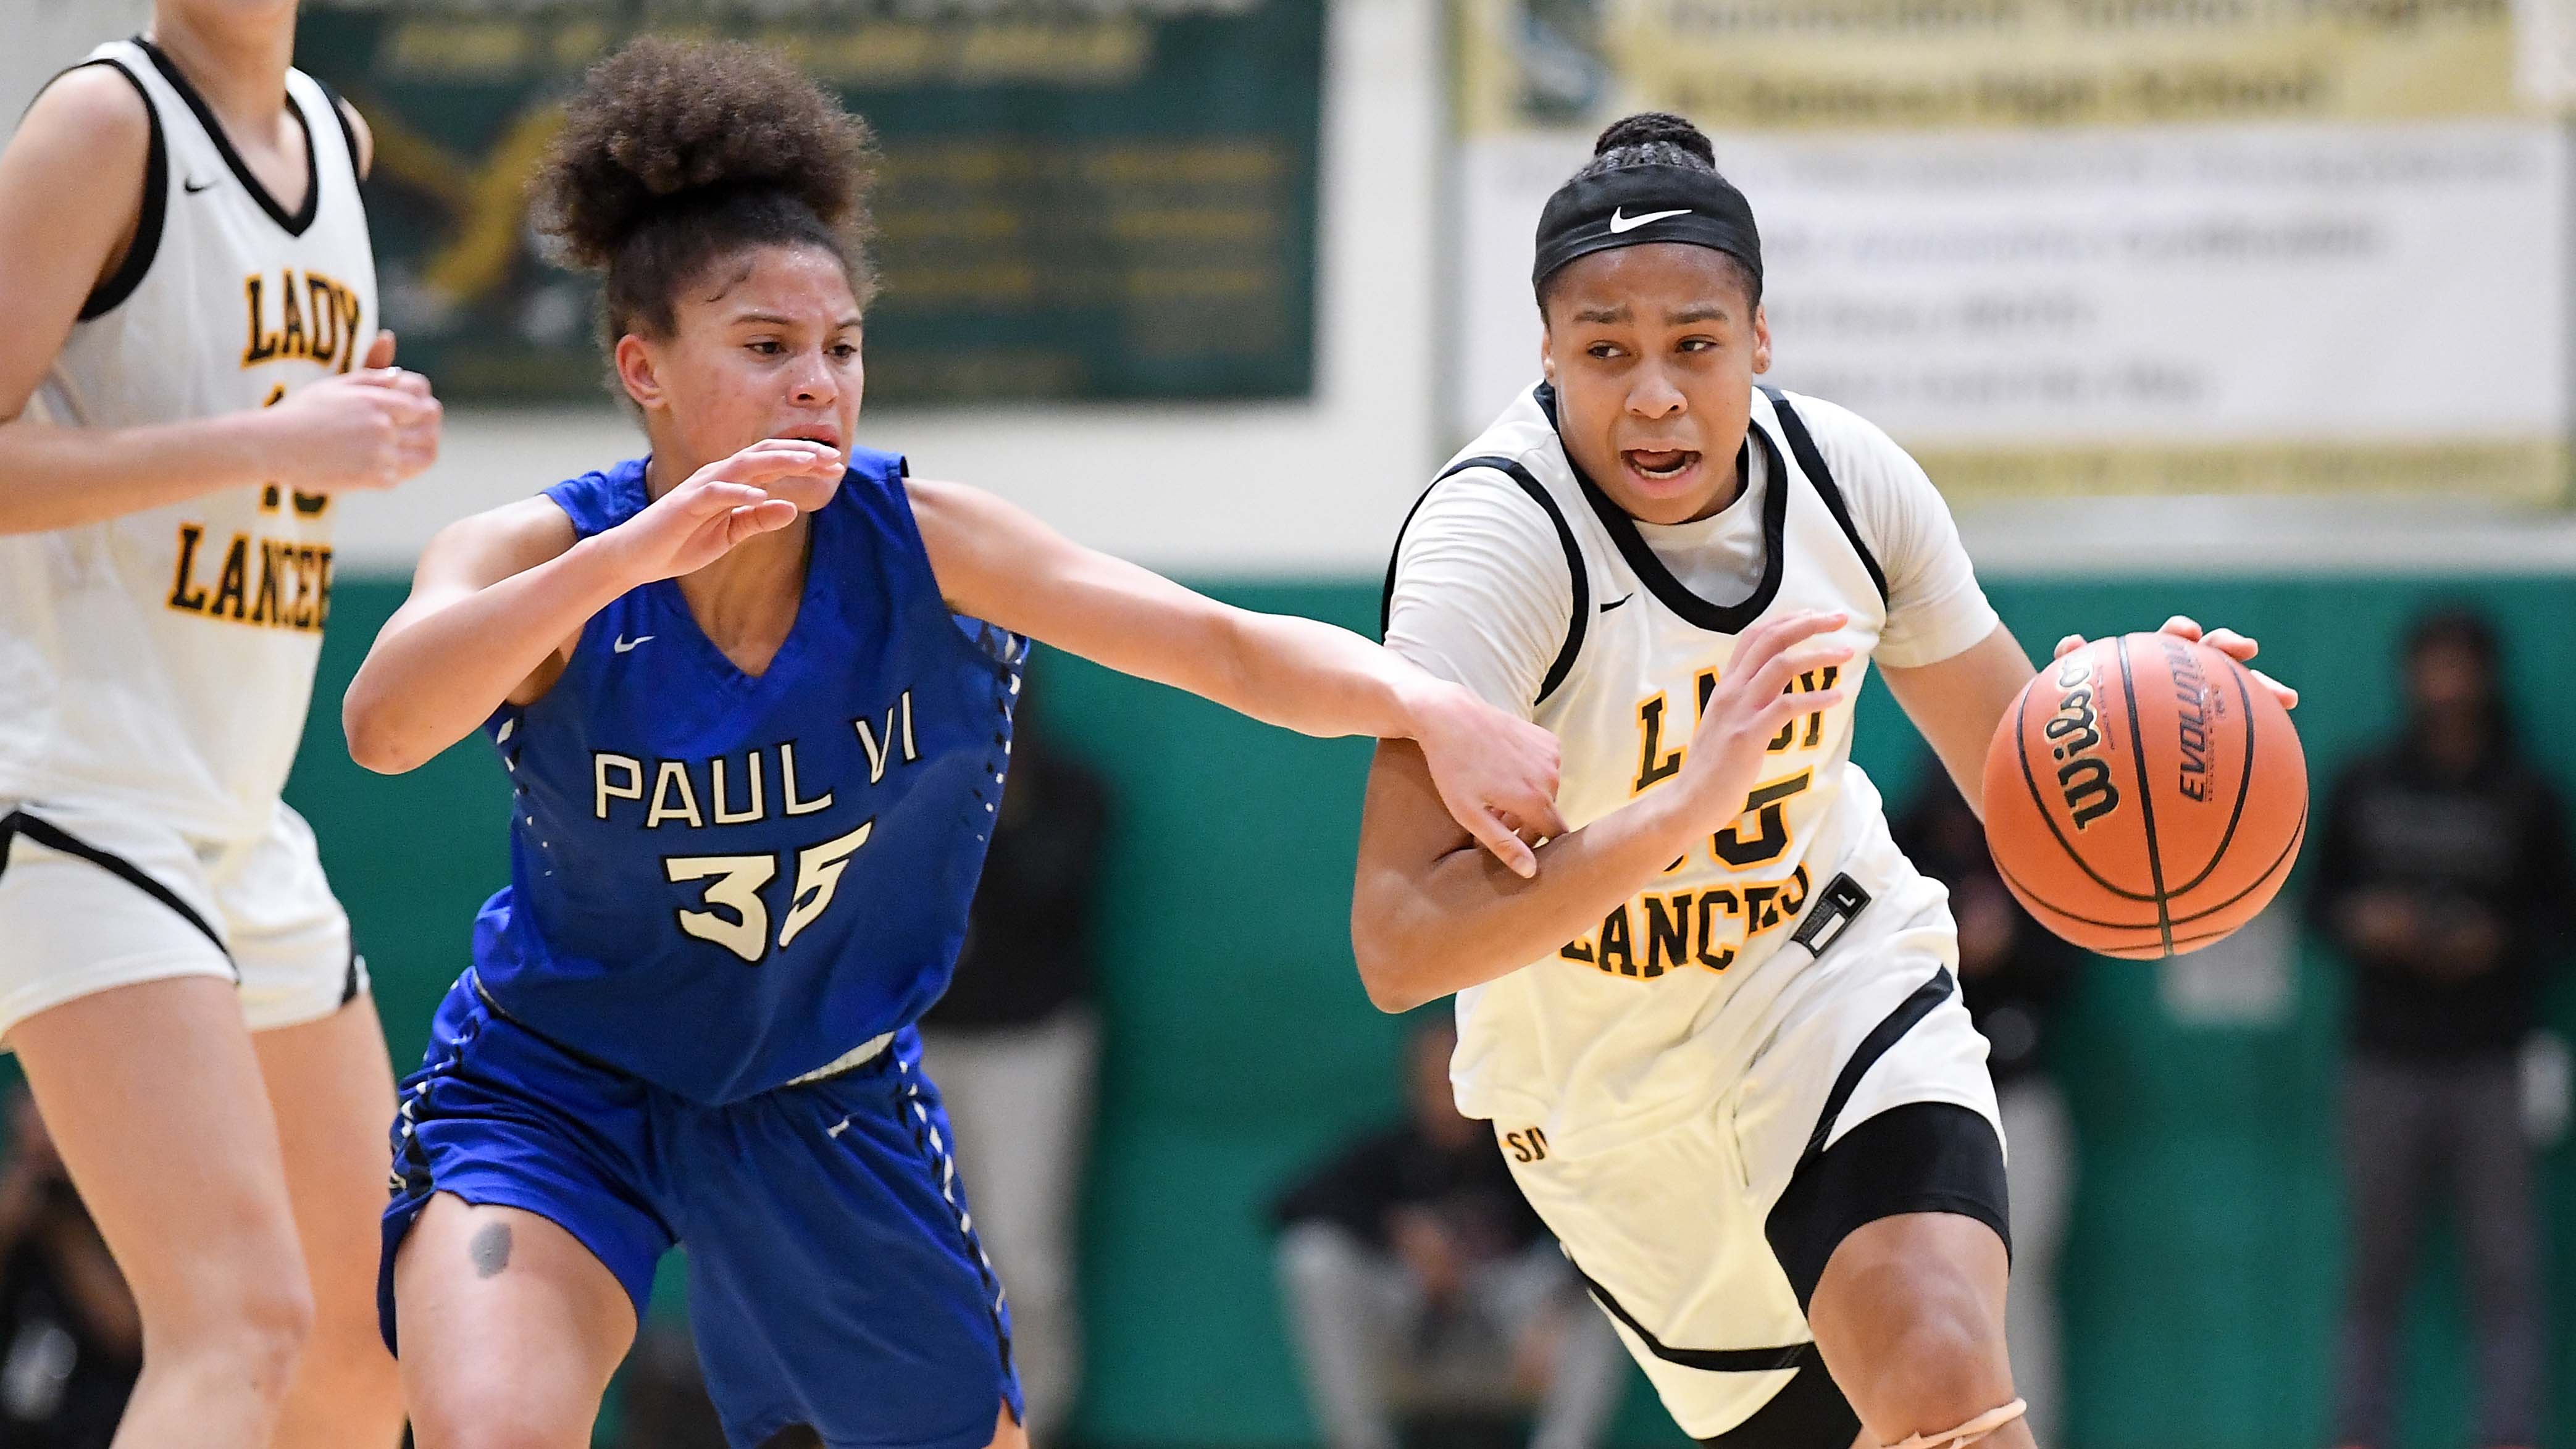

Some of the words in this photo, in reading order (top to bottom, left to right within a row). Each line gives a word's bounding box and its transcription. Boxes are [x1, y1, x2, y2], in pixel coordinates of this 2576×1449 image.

[241, 270, 362, 374] LADY
[591, 741, 835, 830] PAUL
[851, 688, 920, 785] VI
[2044, 645, 2121, 833] Wilso
[2161, 640, 2206, 803] EVOLUT
[1661, 767, 1813, 872] 5
[661, 819, 875, 966] 35
